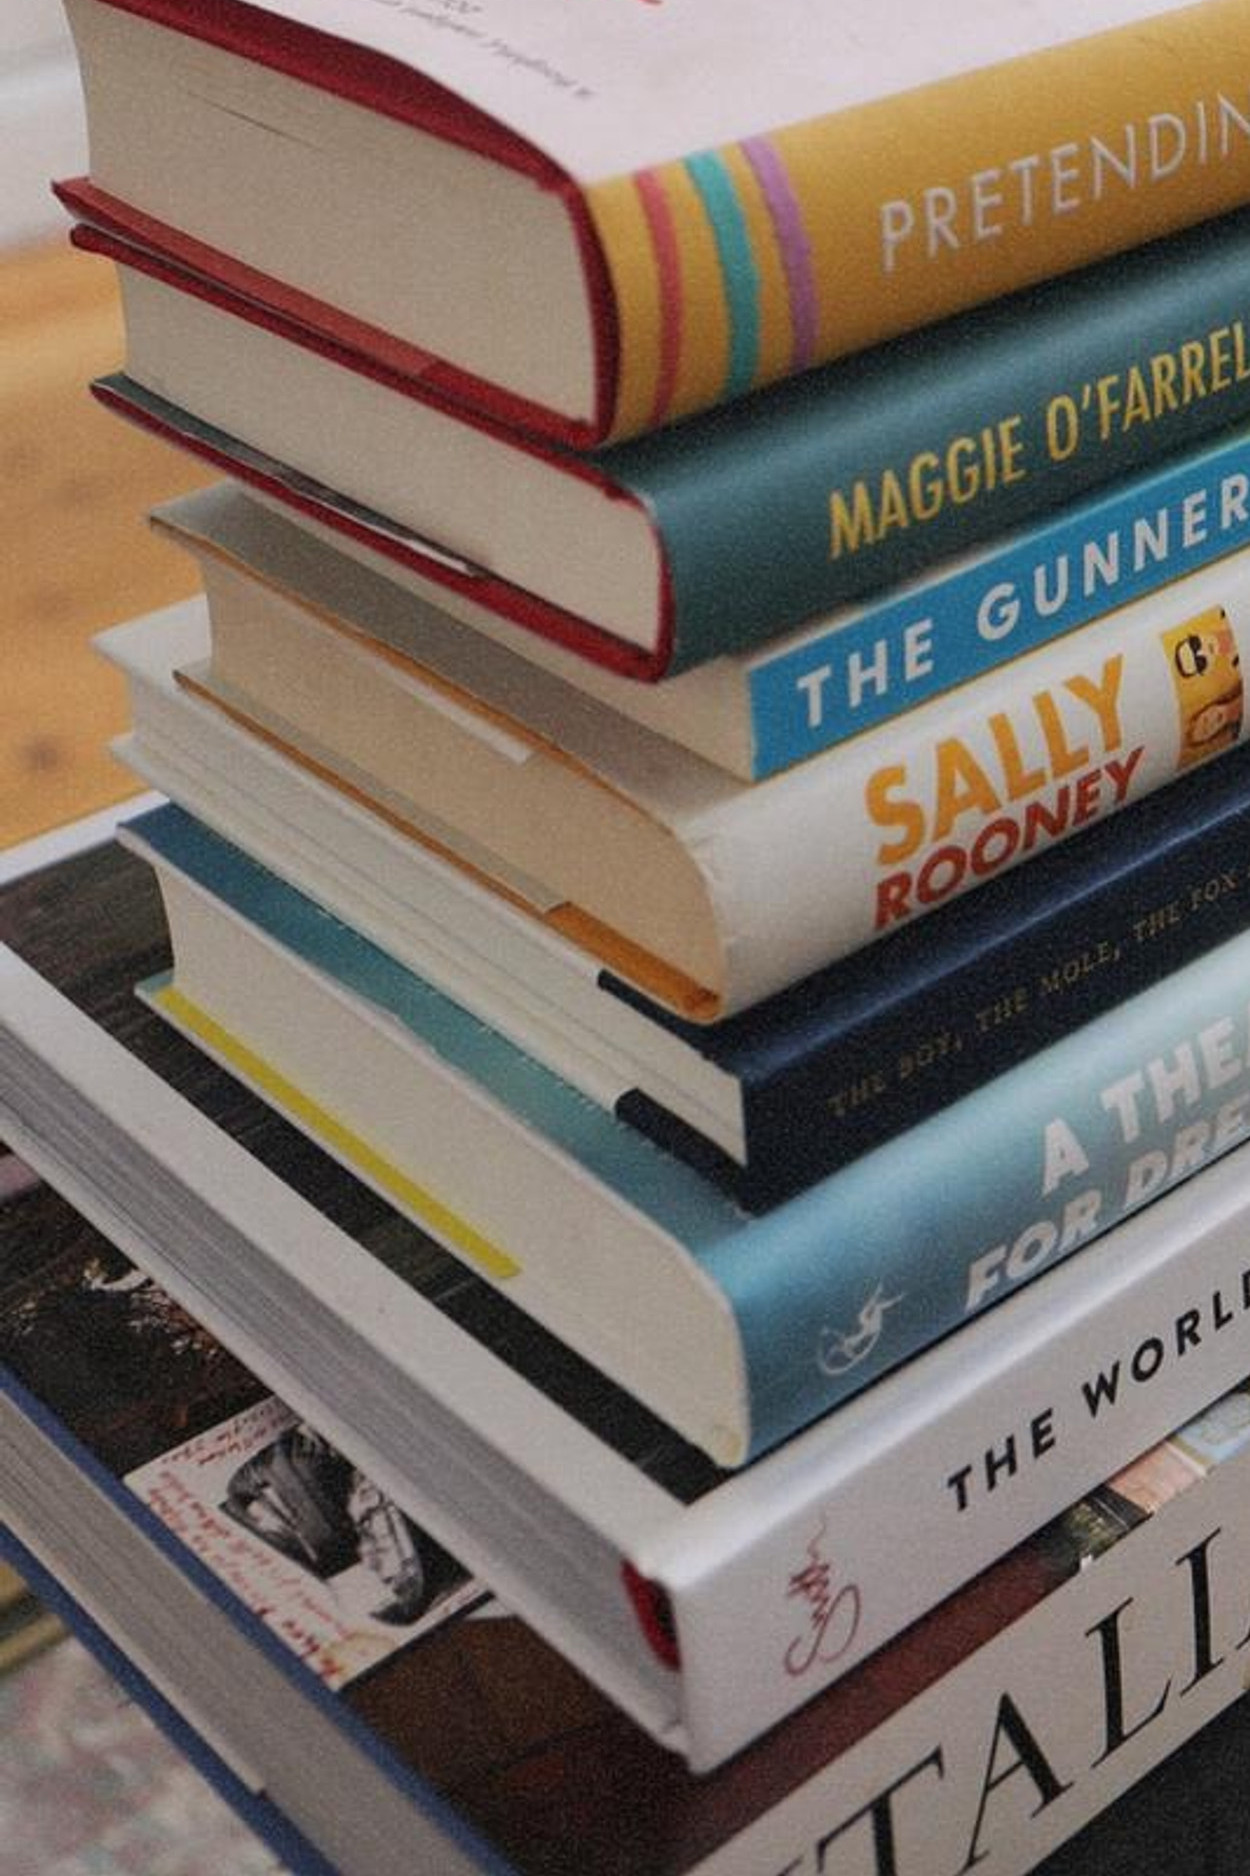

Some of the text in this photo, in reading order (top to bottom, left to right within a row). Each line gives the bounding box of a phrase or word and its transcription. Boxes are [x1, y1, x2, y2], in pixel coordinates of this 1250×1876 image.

[827, 414, 1025, 561] MAGGIE
[796, 620, 935, 729] THE
[864, 653, 1126, 870] SALLY
[873, 745, 1146, 932] ROONEY
[827, 1072, 887, 1117] THE
[975, 986, 1029, 1033] THE
[1132, 902, 1182, 942] THE
[1189, 871, 1239, 912] FOX
[1042, 1118, 1091, 1197] A
[965, 1189, 1103, 1312] FOR
[945, 1408, 1058, 1514] THE
